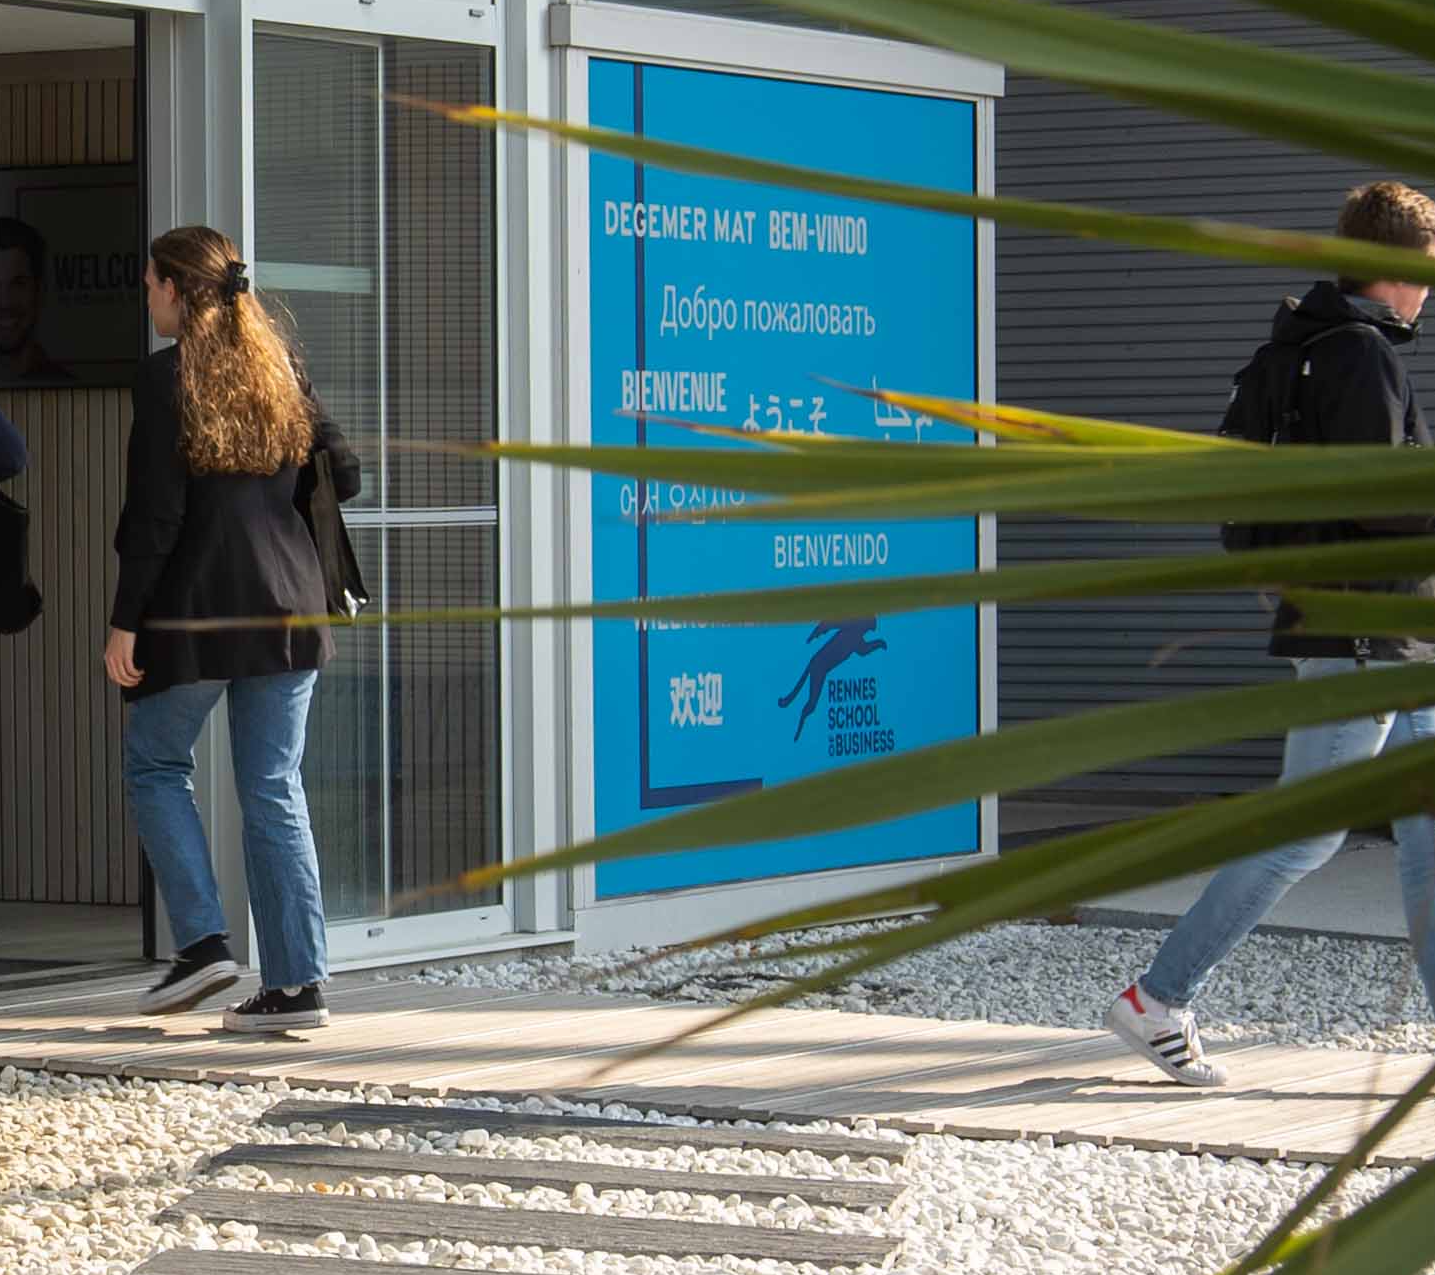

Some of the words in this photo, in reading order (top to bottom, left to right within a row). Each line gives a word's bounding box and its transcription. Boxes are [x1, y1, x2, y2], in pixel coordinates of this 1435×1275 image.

[604, 200, 707, 242] DEGEMER
[713, 210, 756, 245] MAT
[769, 210, 867, 255] BEM-VINDO
[659, 284, 738, 340] Добро
[744, 300, 876, 337] пожаловать
[621, 370, 728, 413] BIENVENUE
[773, 532, 890, 569] BIENVENIDO
[669, 671, 724, 728] 欢迎
[827, 677, 877, 702] RENNES
[827, 703, 881, 730] SCHOOL
[835, 729, 895, 757] BUSINESS
